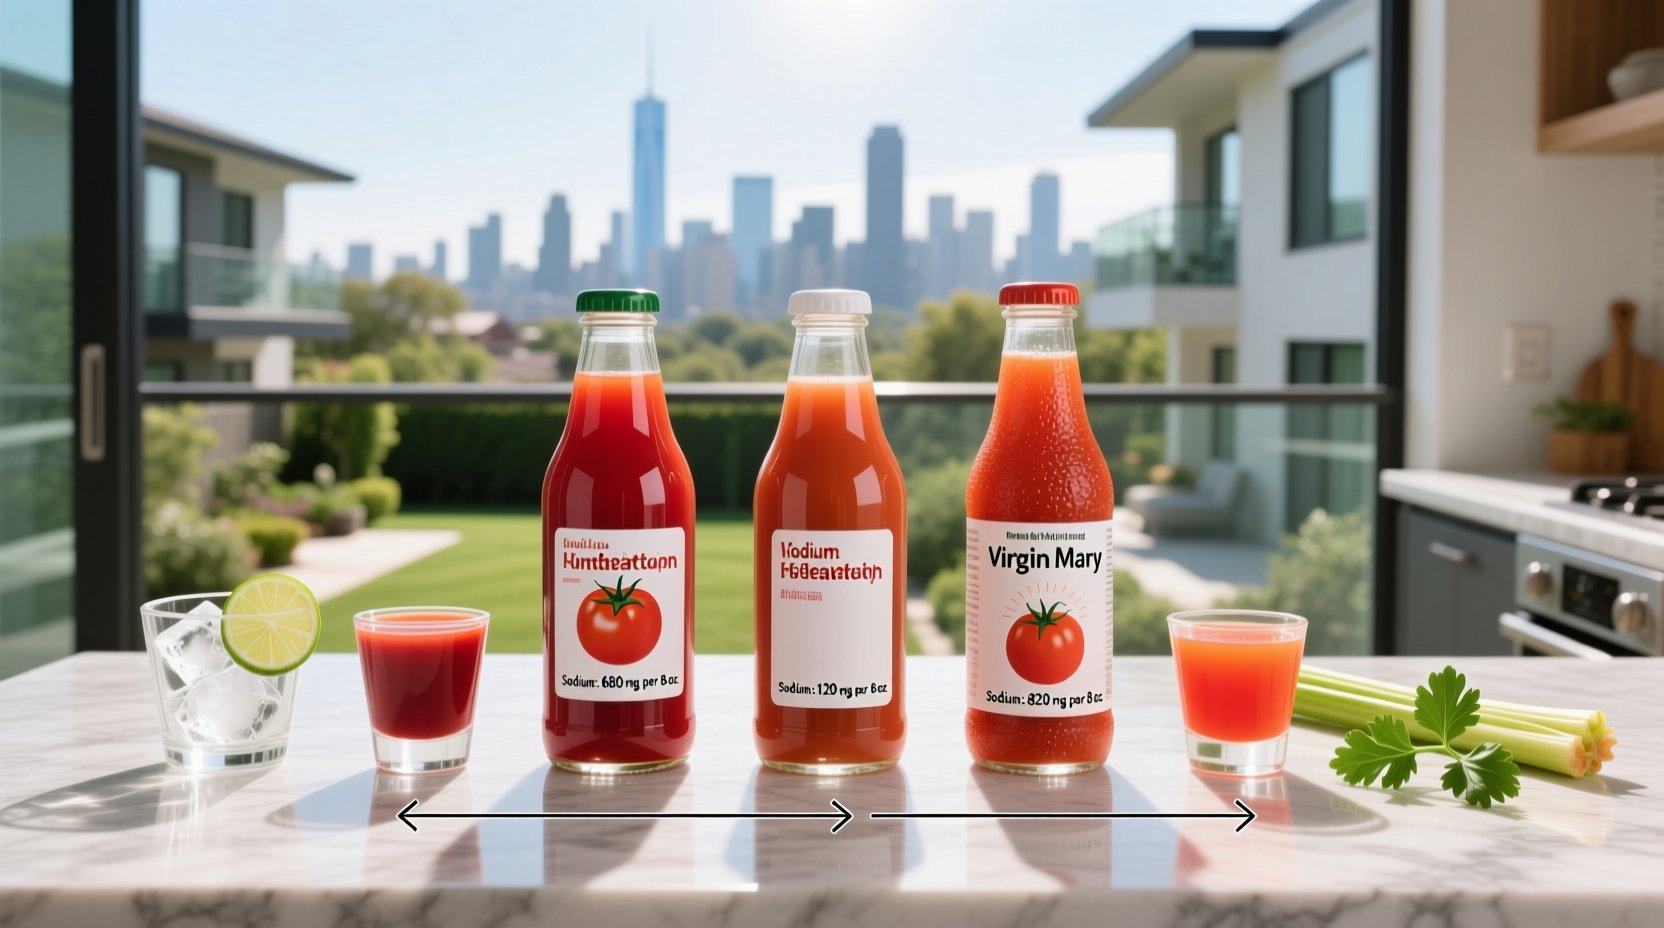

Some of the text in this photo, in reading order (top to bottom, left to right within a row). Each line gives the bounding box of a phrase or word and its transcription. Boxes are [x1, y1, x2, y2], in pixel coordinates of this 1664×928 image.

[988, 545, 1102, 575] Virgin Mary
[817, 682, 838, 696] 120
[1027, 692, 1050, 706] 820
